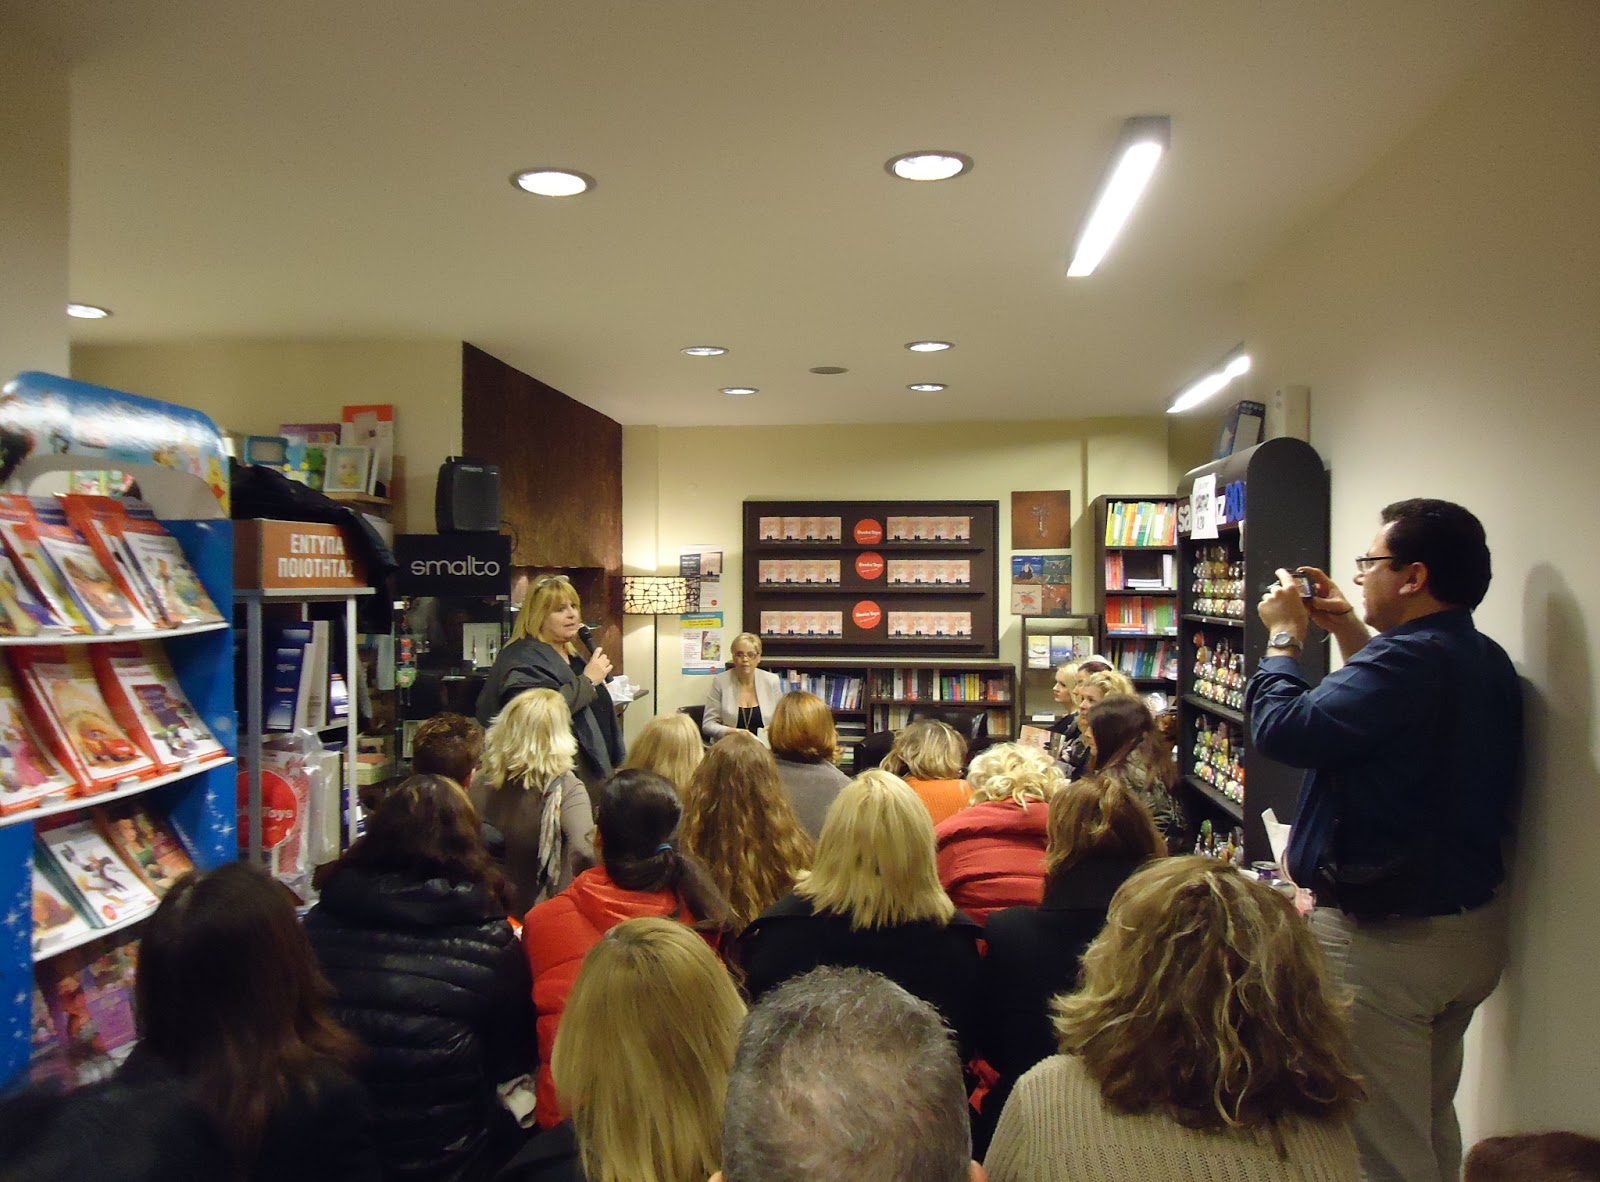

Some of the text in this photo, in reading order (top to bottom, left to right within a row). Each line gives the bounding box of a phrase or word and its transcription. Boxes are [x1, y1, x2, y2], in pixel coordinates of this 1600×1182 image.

[290, 533, 345, 555] ΕΝΤΥΠΑ
[278, 557, 354, 578] ΠΟΙΟΤΗΤΑΣ
[410, 555, 500, 576] smalto
